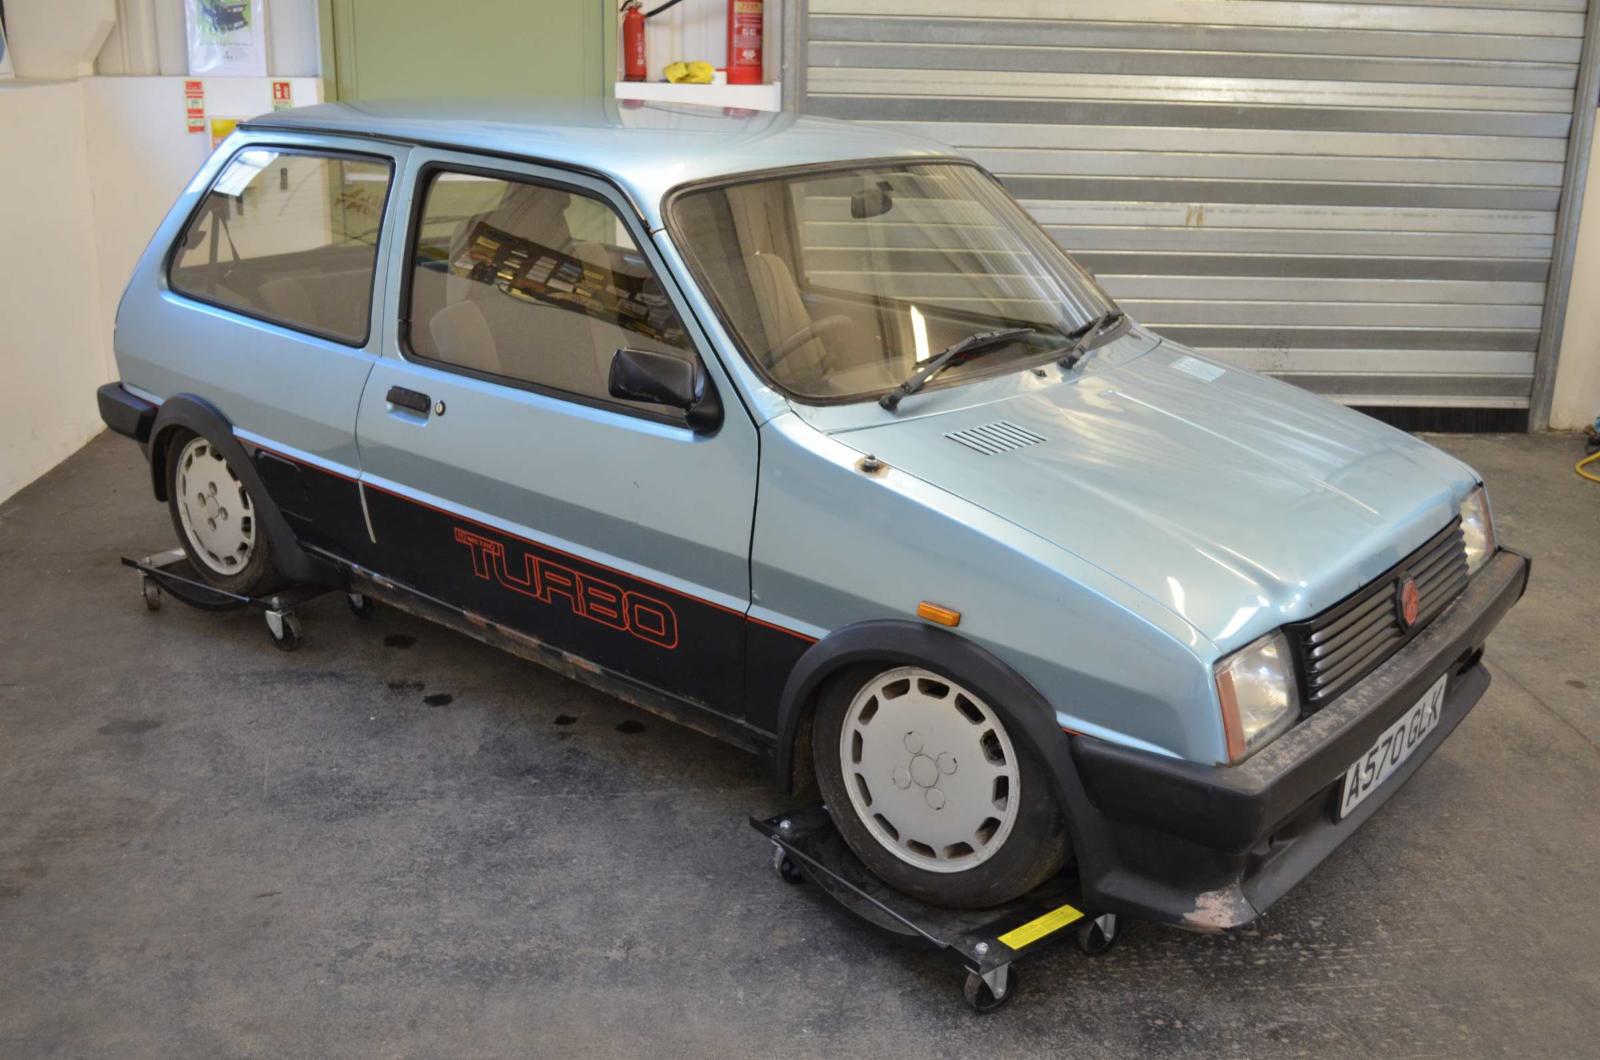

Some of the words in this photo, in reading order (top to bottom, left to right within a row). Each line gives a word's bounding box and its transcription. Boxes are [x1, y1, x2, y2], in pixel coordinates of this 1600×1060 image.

[454, 527, 678, 649] TURBO
[1346, 723, 1406, 807] A570
[1408, 684, 1443, 749] GLK
